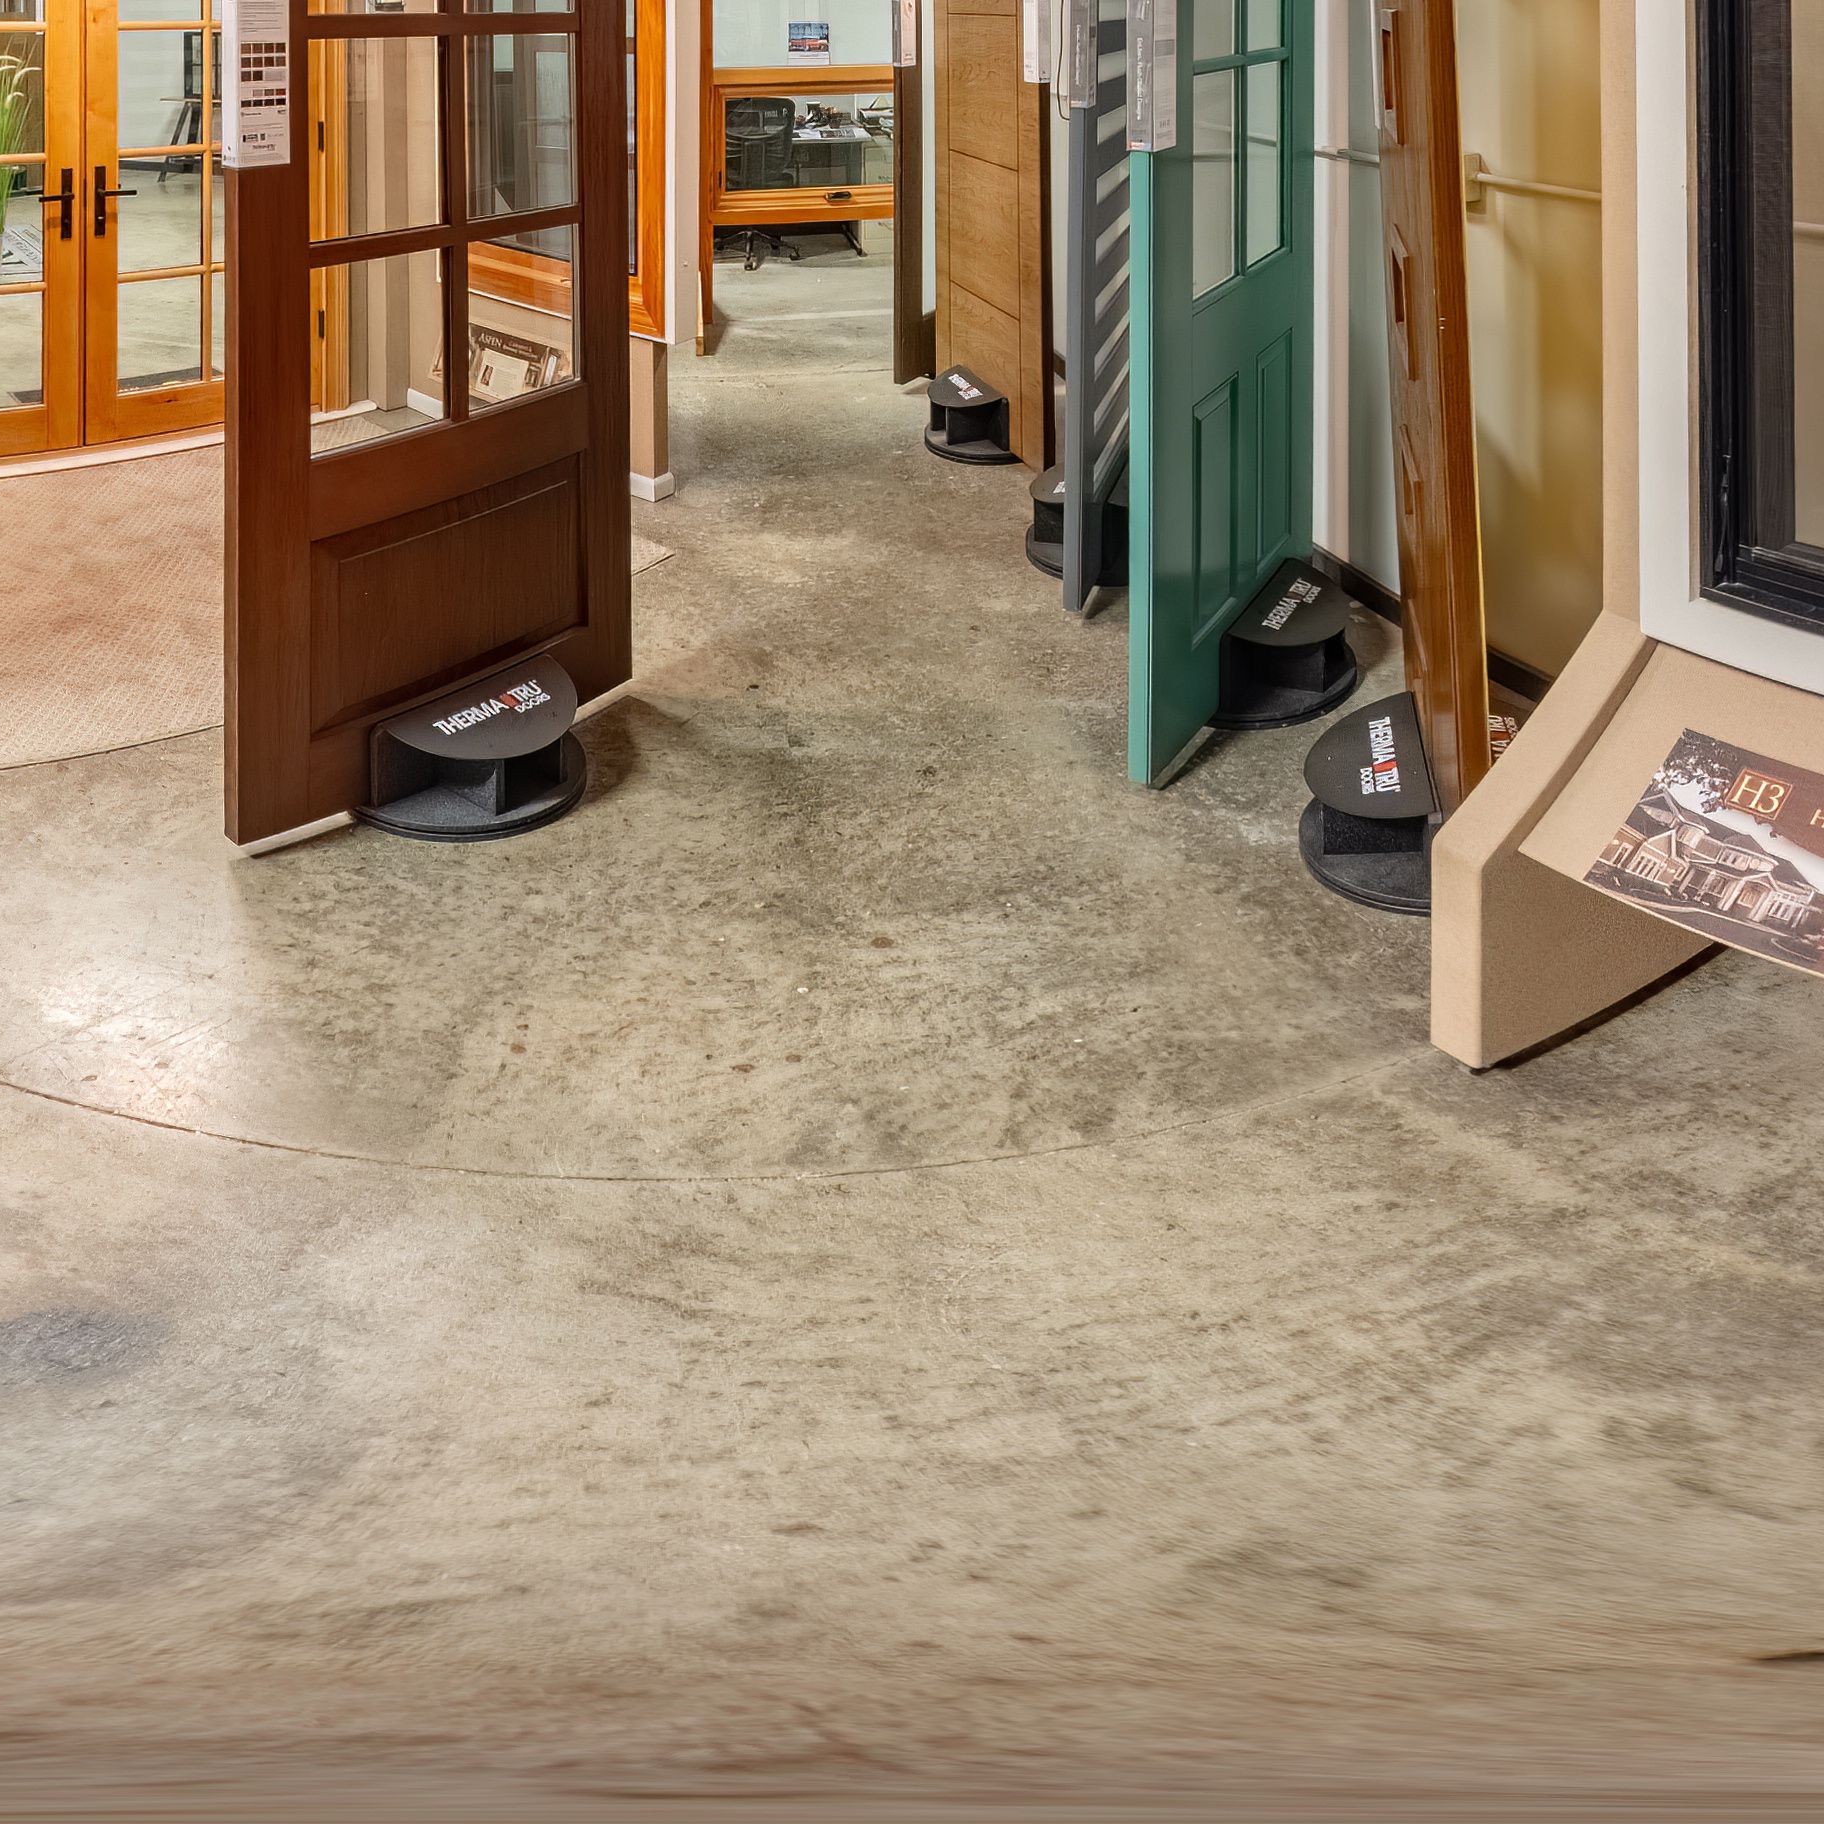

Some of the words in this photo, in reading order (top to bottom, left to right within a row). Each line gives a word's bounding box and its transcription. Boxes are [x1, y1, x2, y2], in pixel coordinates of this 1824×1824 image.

[1261, 596, 1302, 631] THERMA
[1289, 577, 1312, 596] TRU
[432, 698, 509, 736] THERMA
[507, 679, 543, 703] TRU
[1369, 716, 1395, 765] THERMA
[1374, 766, 1401, 793] TRU
[1731, 775, 1785, 813] H3
